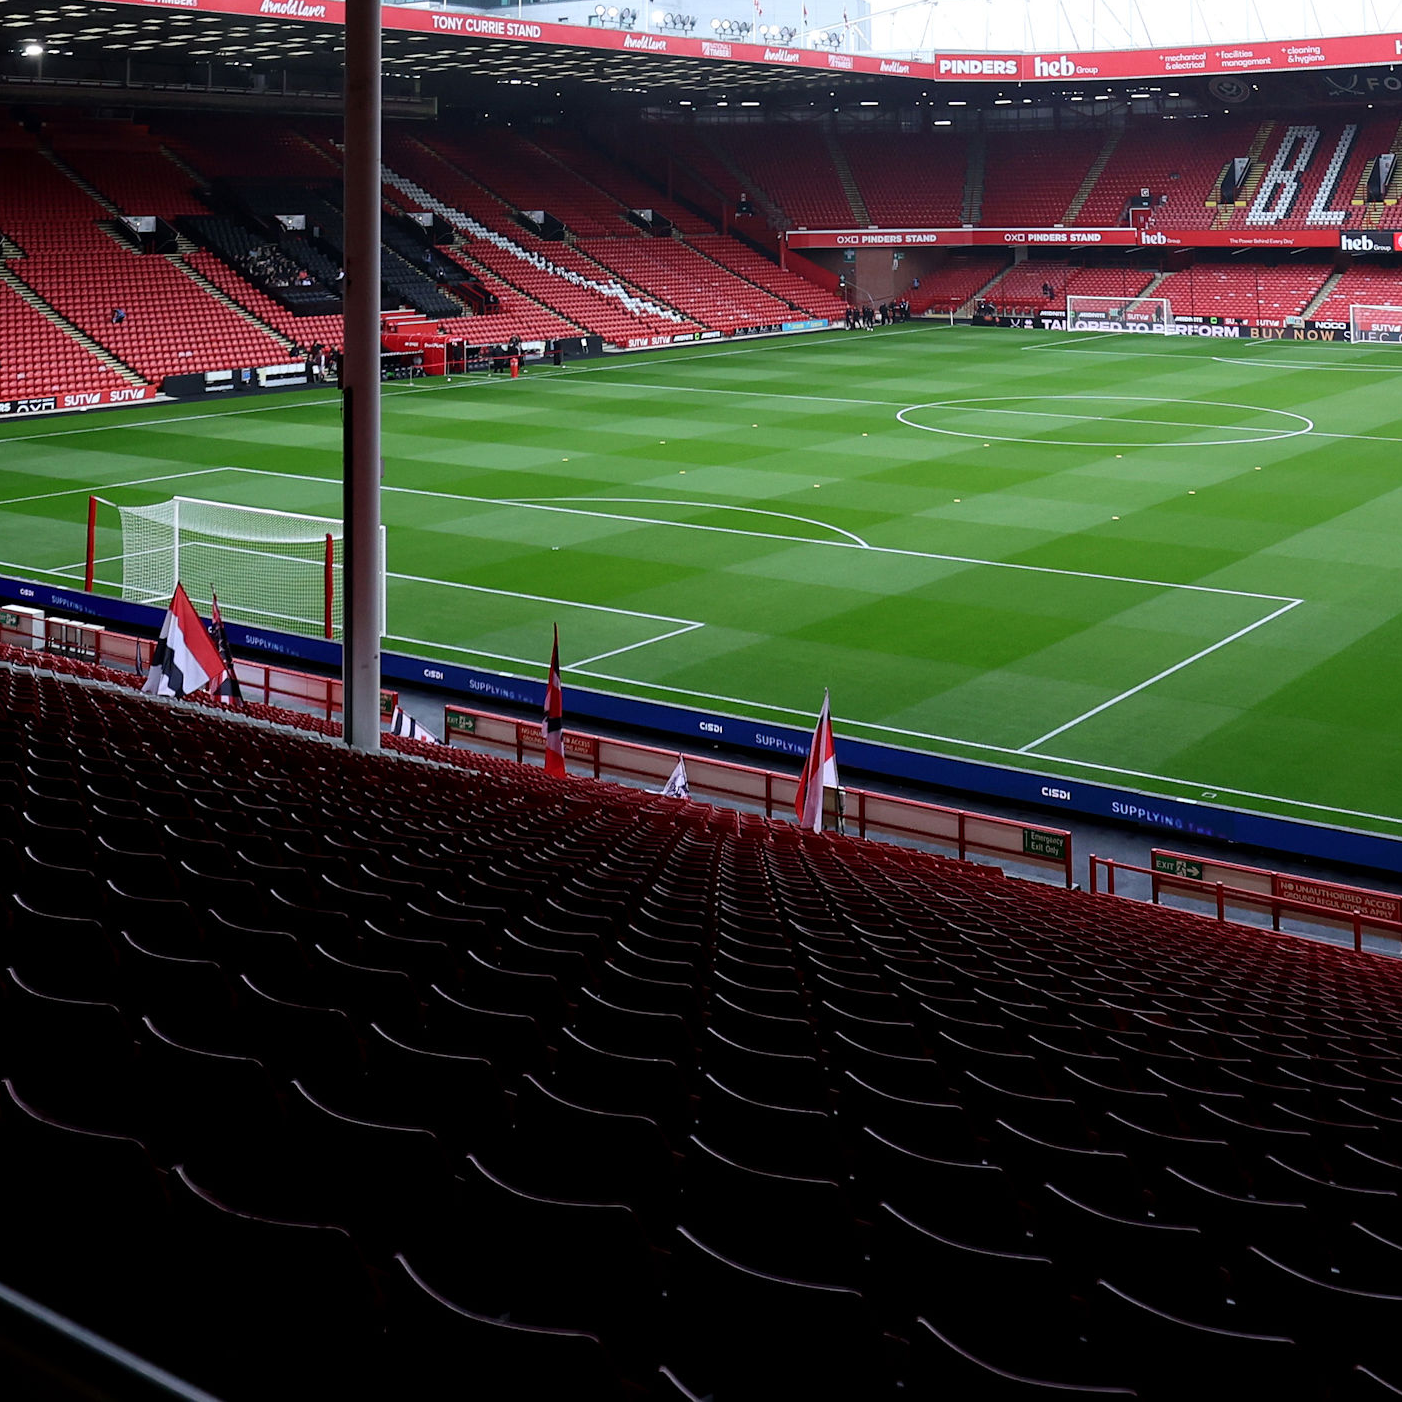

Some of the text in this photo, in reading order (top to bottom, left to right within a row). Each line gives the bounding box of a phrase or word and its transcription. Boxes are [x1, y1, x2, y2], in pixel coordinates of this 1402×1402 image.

[298, 1, 326, 18] Laver
[432, 15, 541, 38] TONY CURRIE STAND
[1165, 52, 1207, 63] mechanical
[1221, 50, 1253, 63] facilities
[1287, 46, 1321, 56] cleaning
[939, 59, 1018, 75] PINDERS
[1034, 55, 1099, 77] heb Group
[1222, 57, 1272, 68] management
[862, 234, 937, 244] PINDERS STAND
[1028, 234, 1101, 242] PINDERS STAND
[1141, 231, 1167, 245] heb
[1341, 235, 1392, 252] heb Group
[1126, 322, 1150, 332] TO
[1315, 321, 1346, 330] NOCO
[1371, 323, 1395, 332] SUTV
[1250, 327, 1334, 341] BUY NOW
[64, 393, 92, 407] SUTV
[110, 389, 138, 402] SUTV
[51, 595, 83, 613] SUPPLYING
[245, 634, 284, 653] SUPPLYING
[423, 668, 444, 680] CISDI
[469, 679, 515, 699] SUPPLYING
[447, 715, 459, 725] EXIT
[699, 721, 722, 734] CISDI
[570, 736, 592, 748] ACCESS
[1041, 786, 1071, 801] CISDI
[1112, 802, 1183, 829] SUPPLYING
[1031, 831, 1063, 847] Emergency
[1031, 841, 1060, 856] Exit Only
[1156, 859, 1175, 871] EXIT
[1280, 882, 1397, 911] NO UNAUTHORISED ACCESS
[1283, 891, 1315, 904] GROUND
[1370, 906, 1394, 919] APPLY
